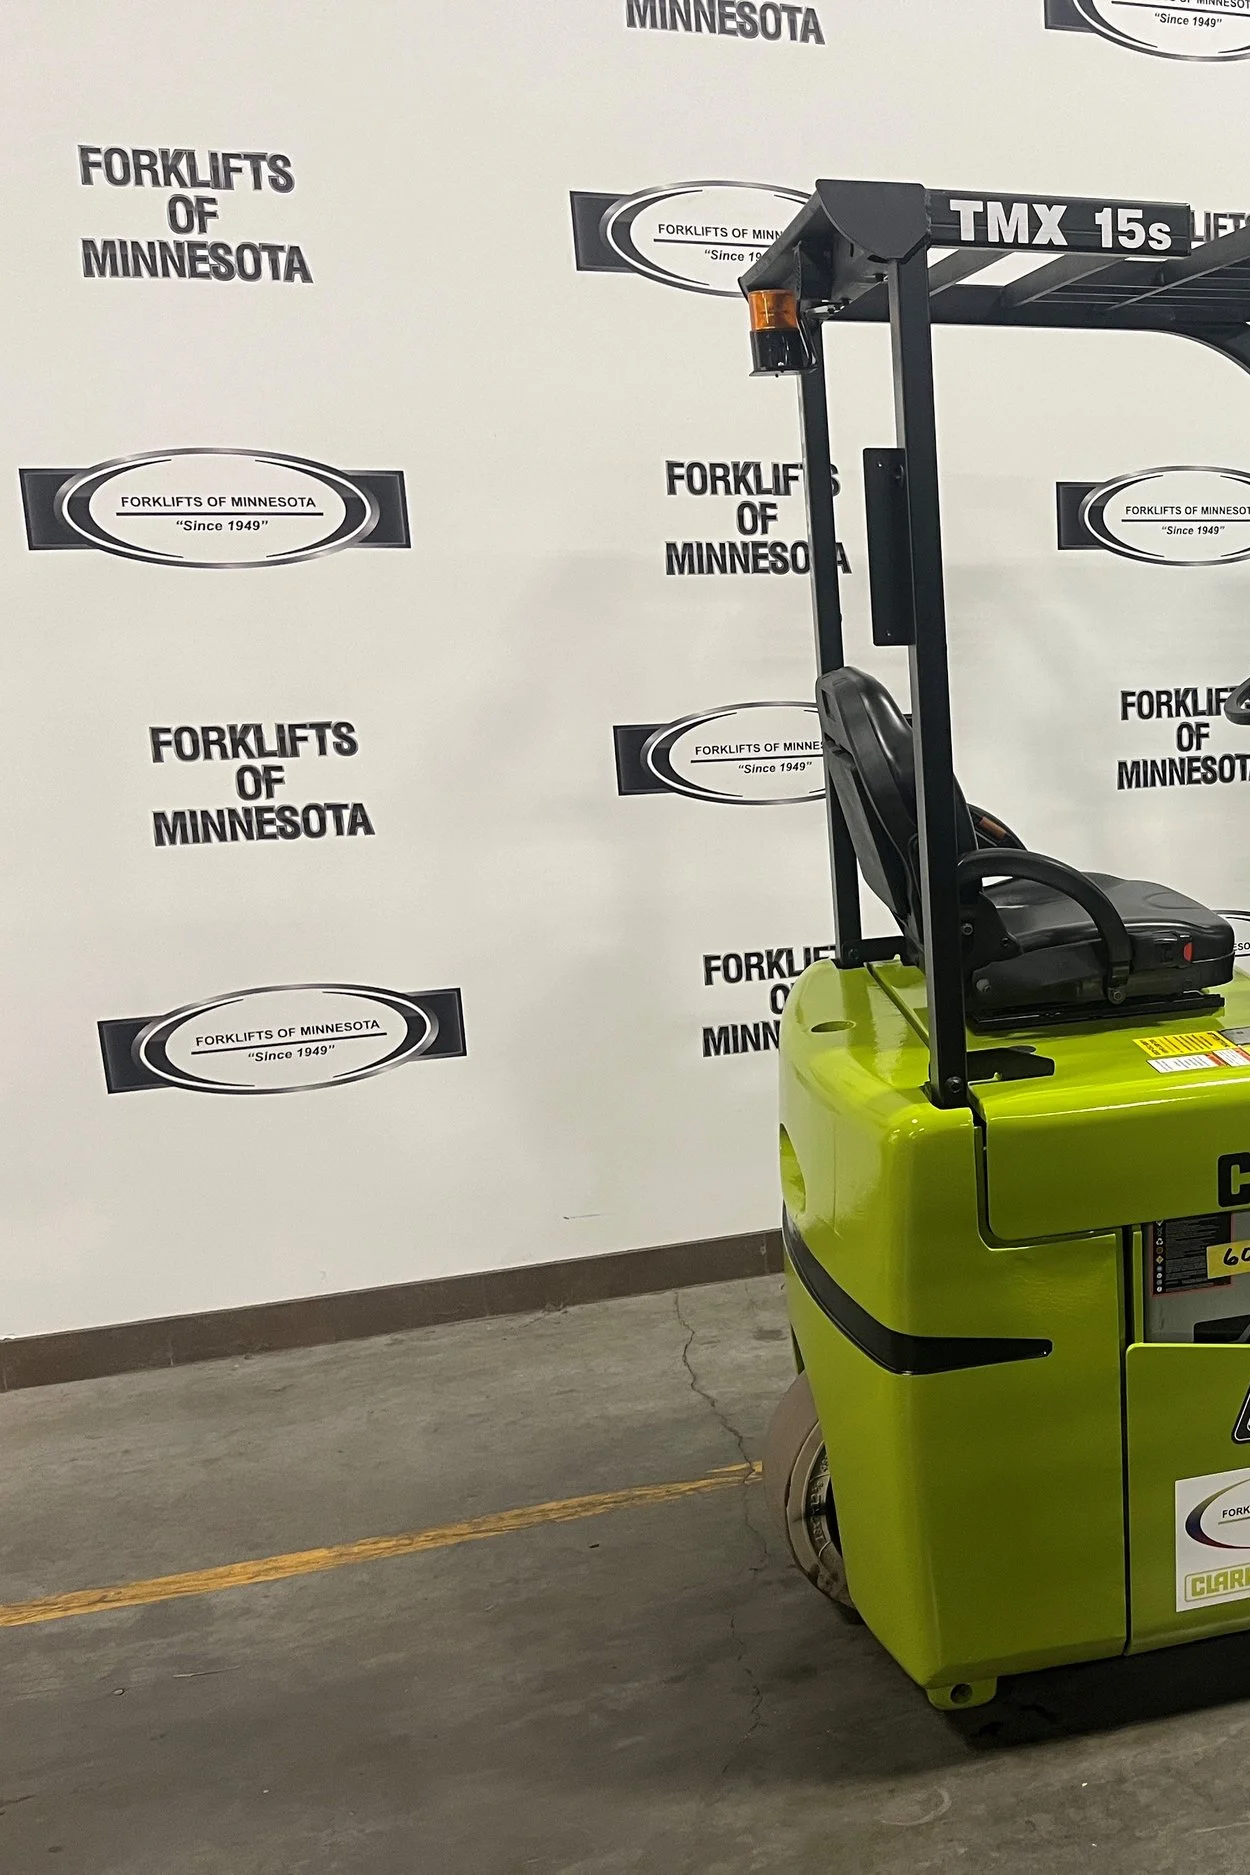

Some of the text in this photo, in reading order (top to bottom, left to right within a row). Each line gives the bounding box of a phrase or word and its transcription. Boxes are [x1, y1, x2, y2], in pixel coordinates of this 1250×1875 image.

[626, 0, 826, 45] MINNESOTA
[1154, 13, 1222, 28] “Since 1949”
[77, 145, 295, 194] FORKLIFTS
[167, 194, 219, 235] OF
[949, 199, 1172, 250] TMX 15s
[658, 223, 728, 238] FORKLIFTS
[731, 228, 749, 238] OF
[80, 238, 314, 284] MINNESOTA
[704, 248, 745, 262] “Since
[665, 460, 841, 496] FORKLIFS
[121, 496, 316, 507] FORKLIFTS OF MINNESOTA
[1125, 506, 1182, 515] FORKLIFTS
[1184, 506, 1199, 515] OF
[176, 520, 268, 531] “Since 1949”
[736, 500, 778, 536] OF
[1161, 526, 1225, 536] “Since 1949”
[665, 541, 852, 576] MINNESOA
[149, 721, 359, 764] FORKLIFTS
[695, 743, 761, 756] FORKLIFTS
[764, 742, 780, 753] OF
[1176, 721, 1210, 752] OF
[235, 764, 285, 801] OF
[738, 761, 812, 774] “Since 1949”
[152, 802, 376, 847] MINNESOTA
[195, 1019, 380, 1047] FORKLIFTS OF MINNESOTA
[248, 1045, 335, 1062] “Since 1949”
